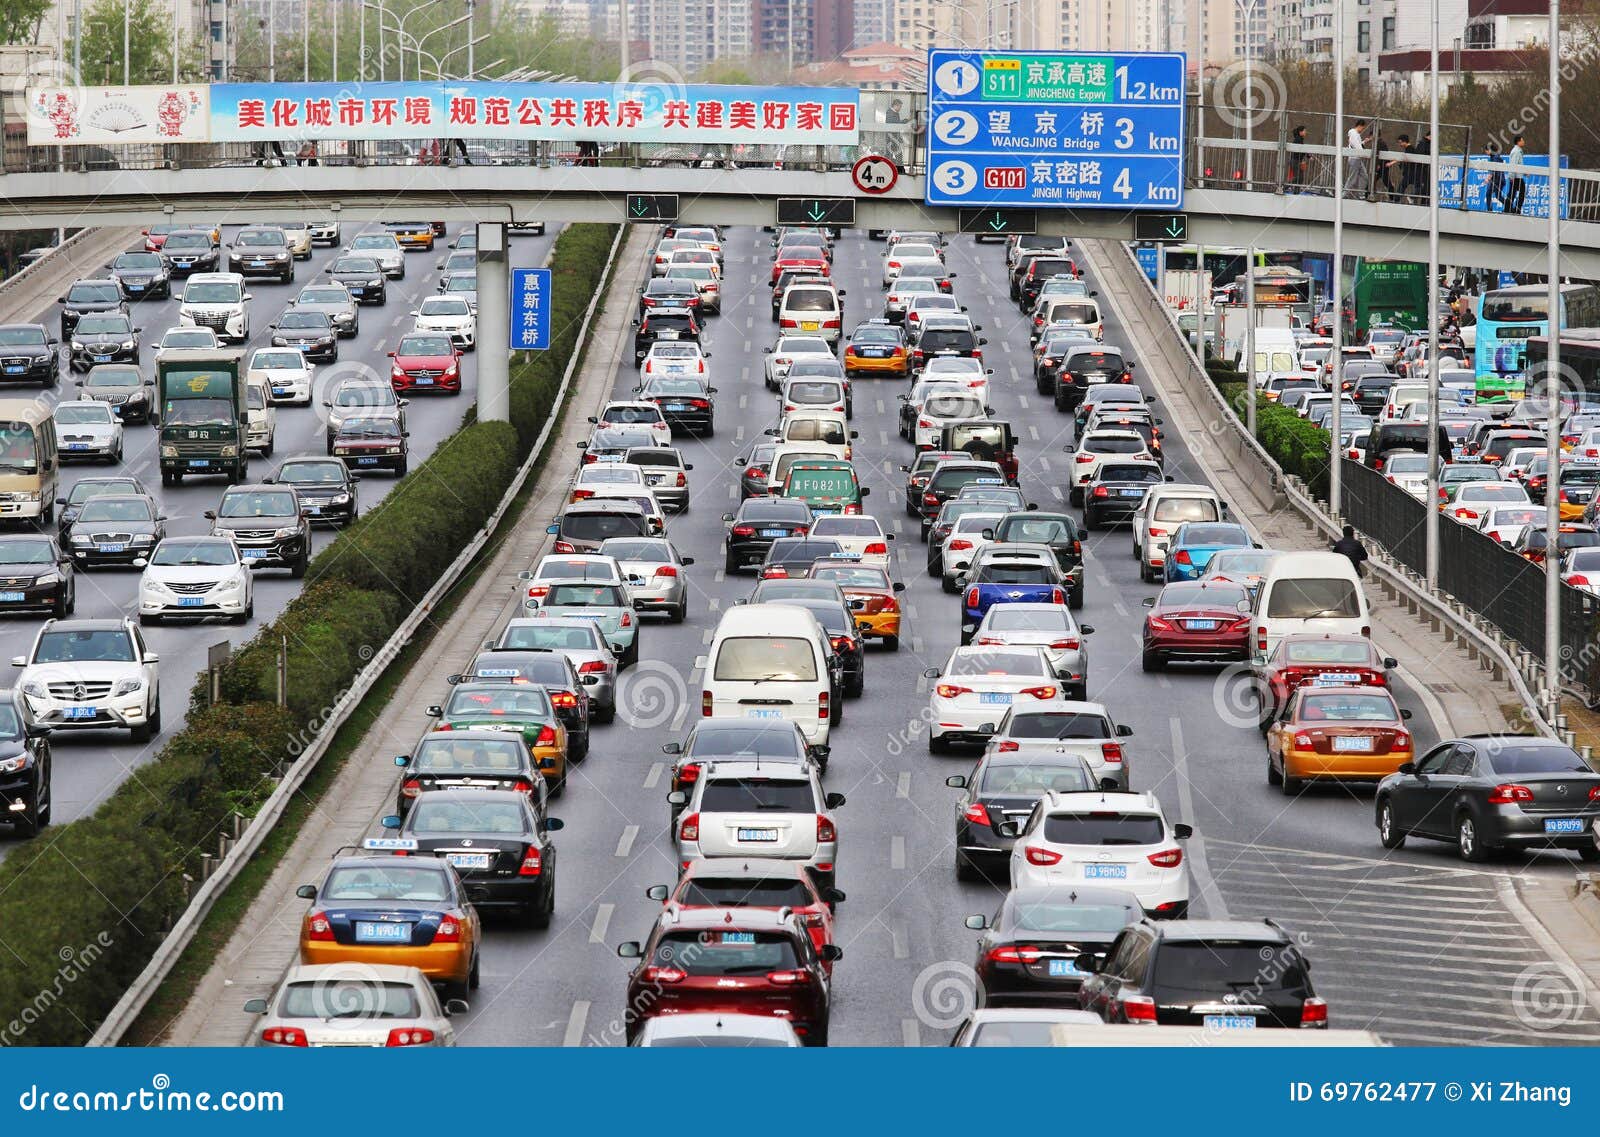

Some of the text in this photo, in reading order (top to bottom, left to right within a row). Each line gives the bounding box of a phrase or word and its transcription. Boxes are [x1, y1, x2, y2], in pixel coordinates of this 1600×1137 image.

[952, 66, 963, 89] 1
[989, 74, 1016, 92] S11
[1026, 61, 1107, 86] 京承高速
[1026, 88, 1106, 101] JINGCHENG Expwy
[1150, 82, 1179, 100] km
[238, 97, 857, 131] 美化城市环境 规范公共秩序 共建美好家园
[988, 110, 1104, 136] 望京桥
[946, 116, 966, 139] 2
[1115, 118, 1178, 150] 3 km
[992, 136, 1100, 150] WANGJING Bridge
[861, 166, 872, 183] 4
[946, 166, 965, 189] 3
[987, 170, 1024, 188] G101
[1031, 160, 1102, 185] 京密路
[1113, 168, 1177, 200] 4 km
[1032, 189, 1102, 200] JINGMI Highway
[522, 273, 540, 345] 惠新东桥
